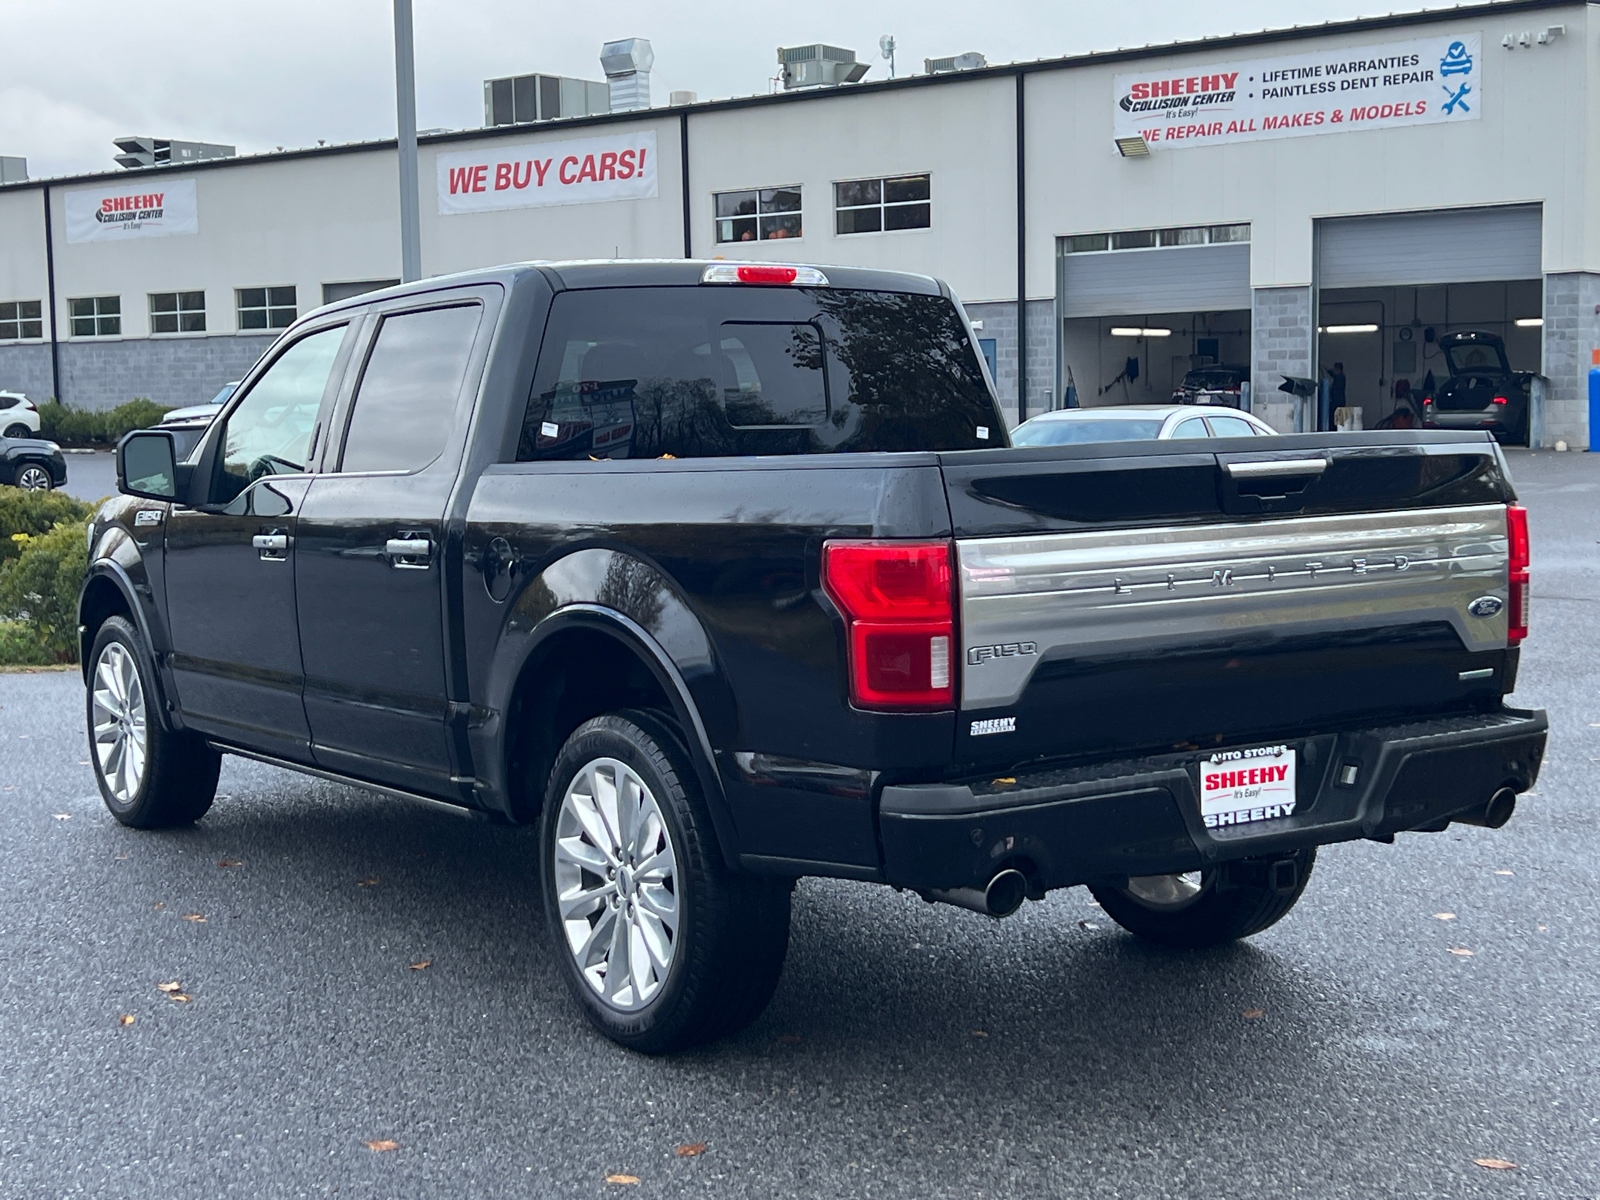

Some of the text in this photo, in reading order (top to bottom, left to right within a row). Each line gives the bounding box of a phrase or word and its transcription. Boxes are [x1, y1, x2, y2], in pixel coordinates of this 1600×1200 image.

[1262, 54, 1420, 83] LIFETIME WARRANTIES
[1131, 72, 1239, 100] SHEEHY
[1262, 70, 1434, 99] PAINTLESS DENT REPAIR
[1131, 91, 1236, 112] COLLISION CENTER
[1165, 107, 1198, 119] It's Easy!
[1165, 121, 1223, 140] REPAIR
[1226, 118, 1257, 134] ALL
[1262, 111, 1325, 130] MAKES
[1330, 109, 1344, 123] &
[1350, 100, 1427, 121] MODELS
[449, 149, 646, 194] WE BUY CARS!
[102, 193, 164, 212] SHEEHY
[103, 209, 164, 223] COLLISION CENTER
[1114, 555, 1411, 595] LIMITED
[971, 717, 1016, 730] SHEEHY
[1205, 764, 1288, 791] SHEEHY
[1233, 787, 1261, 799] It's Easy!
[1203, 803, 1296, 828] SHEEHY
